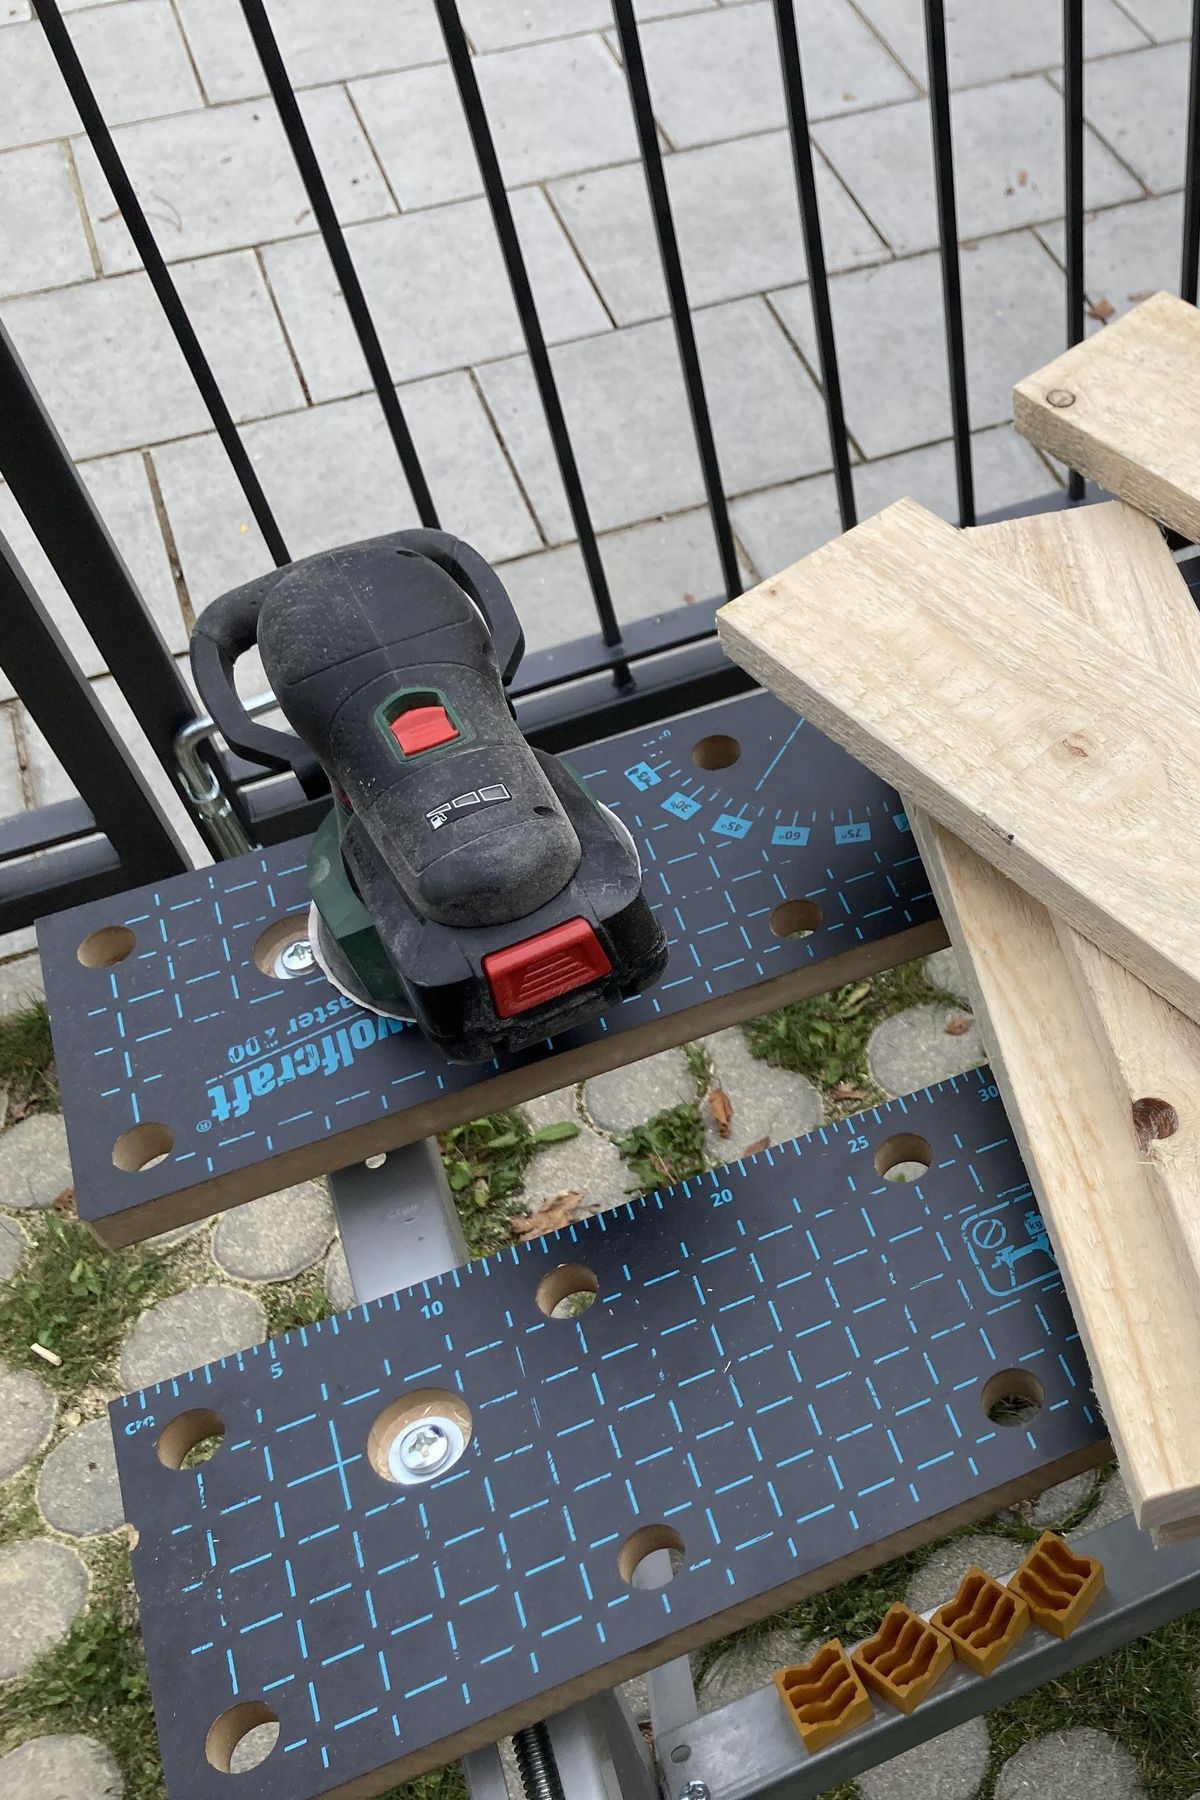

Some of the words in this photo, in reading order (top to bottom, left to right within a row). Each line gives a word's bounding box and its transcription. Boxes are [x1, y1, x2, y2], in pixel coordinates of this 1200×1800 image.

[287, 995, 355, 1036] aster
[207, 1016, 418, 1122] wolfcraft
[977, 1084, 999, 1103] 30
[847, 1135, 870, 1154] 25
[710, 1188, 733, 1207] 20
[420, 1300, 444, 1320] 10
[270, 1362, 284, 1380] 5
